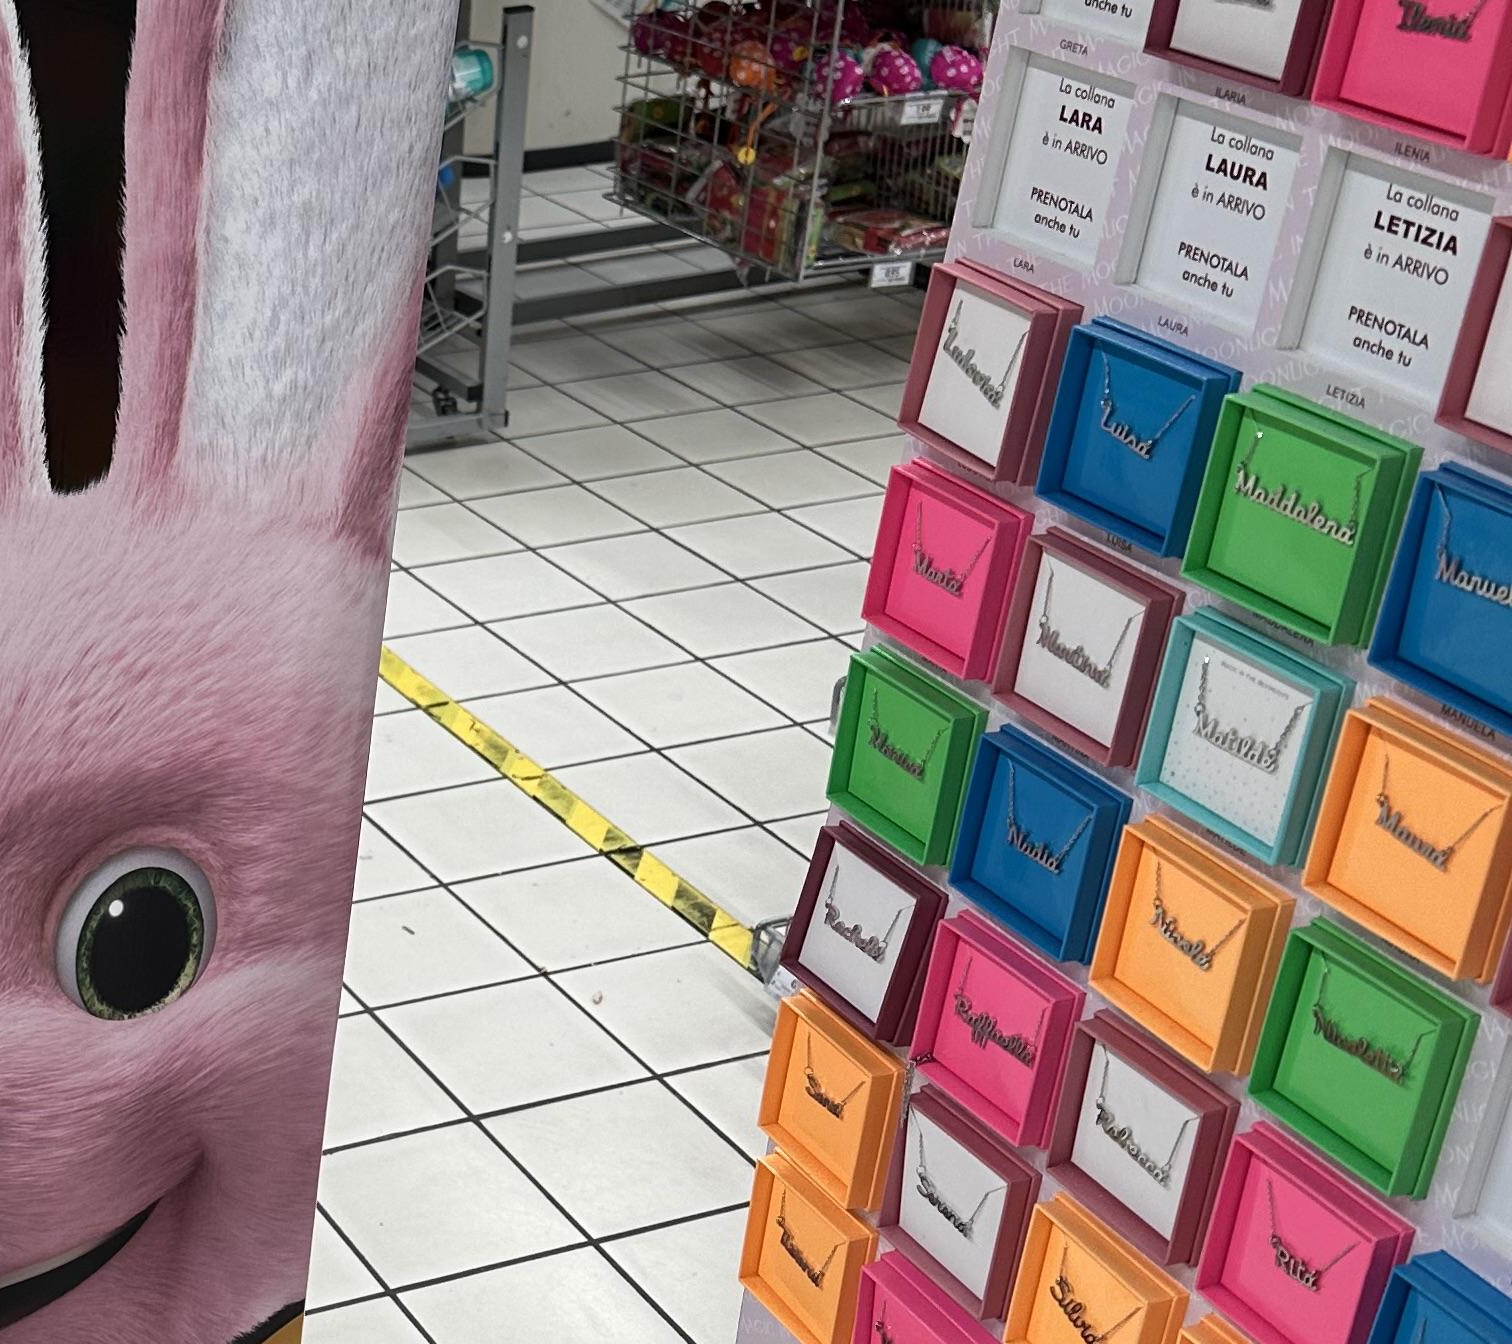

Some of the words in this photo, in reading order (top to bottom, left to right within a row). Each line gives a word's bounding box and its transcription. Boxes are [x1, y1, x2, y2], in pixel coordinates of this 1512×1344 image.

[1121, 3, 1133, 18] tu
[1060, 39, 1088, 56] GRETA
[1059, 77, 1073, 95] La
[1075, 83, 1116, 109] collana
[1214, 86, 1247, 106] ILARIA
[1058, 104, 1105, 135] LARA
[1042, 131, 1049, 146] è
[1051, 134, 1063, 151] in
[1064, 138, 1109, 165] ARRIVO
[1210, 126, 1225, 145] La
[1228, 131, 1275, 161] collana
[1394, 142, 1431, 163] ILENIA
[1205, 153, 1269, 191] LAURA
[1030, 186, 1094, 223] PRENOTALA
[1191, 183, 1199, 200] è
[1203, 186, 1215, 204] in
[1216, 190, 1267, 222] ARRIVO
[1386, 182, 1402, 203] La
[1406, 187, 1460, 222] collana
[1033, 212, 1065, 235] anche
[1068, 223, 1081, 239] tu
[1374, 209, 1460, 256] LETIZIA
[1013, 257, 1035, 274] LARA
[1178, 240, 1249, 282] PRENOTALA
[1364, 243, 1373, 261] è
[1376, 245, 1390, 265] in
[1391, 250, 1450, 287] ARRIVO
[1182, 267, 1219, 294] anche
[1221, 281, 1234, 299] tu
[1157, 314, 1190, 337] LAURA
[1348, 304, 1430, 350] PRENOTALA
[1352, 333, 1394, 361] anche
[1397, 350, 1413, 368] tu
[1326, 383, 1366, 409] LETIZIA
[1234, 467, 1356, 546] Maddalena
[1273, 1246, 1321, 1294] Rita
